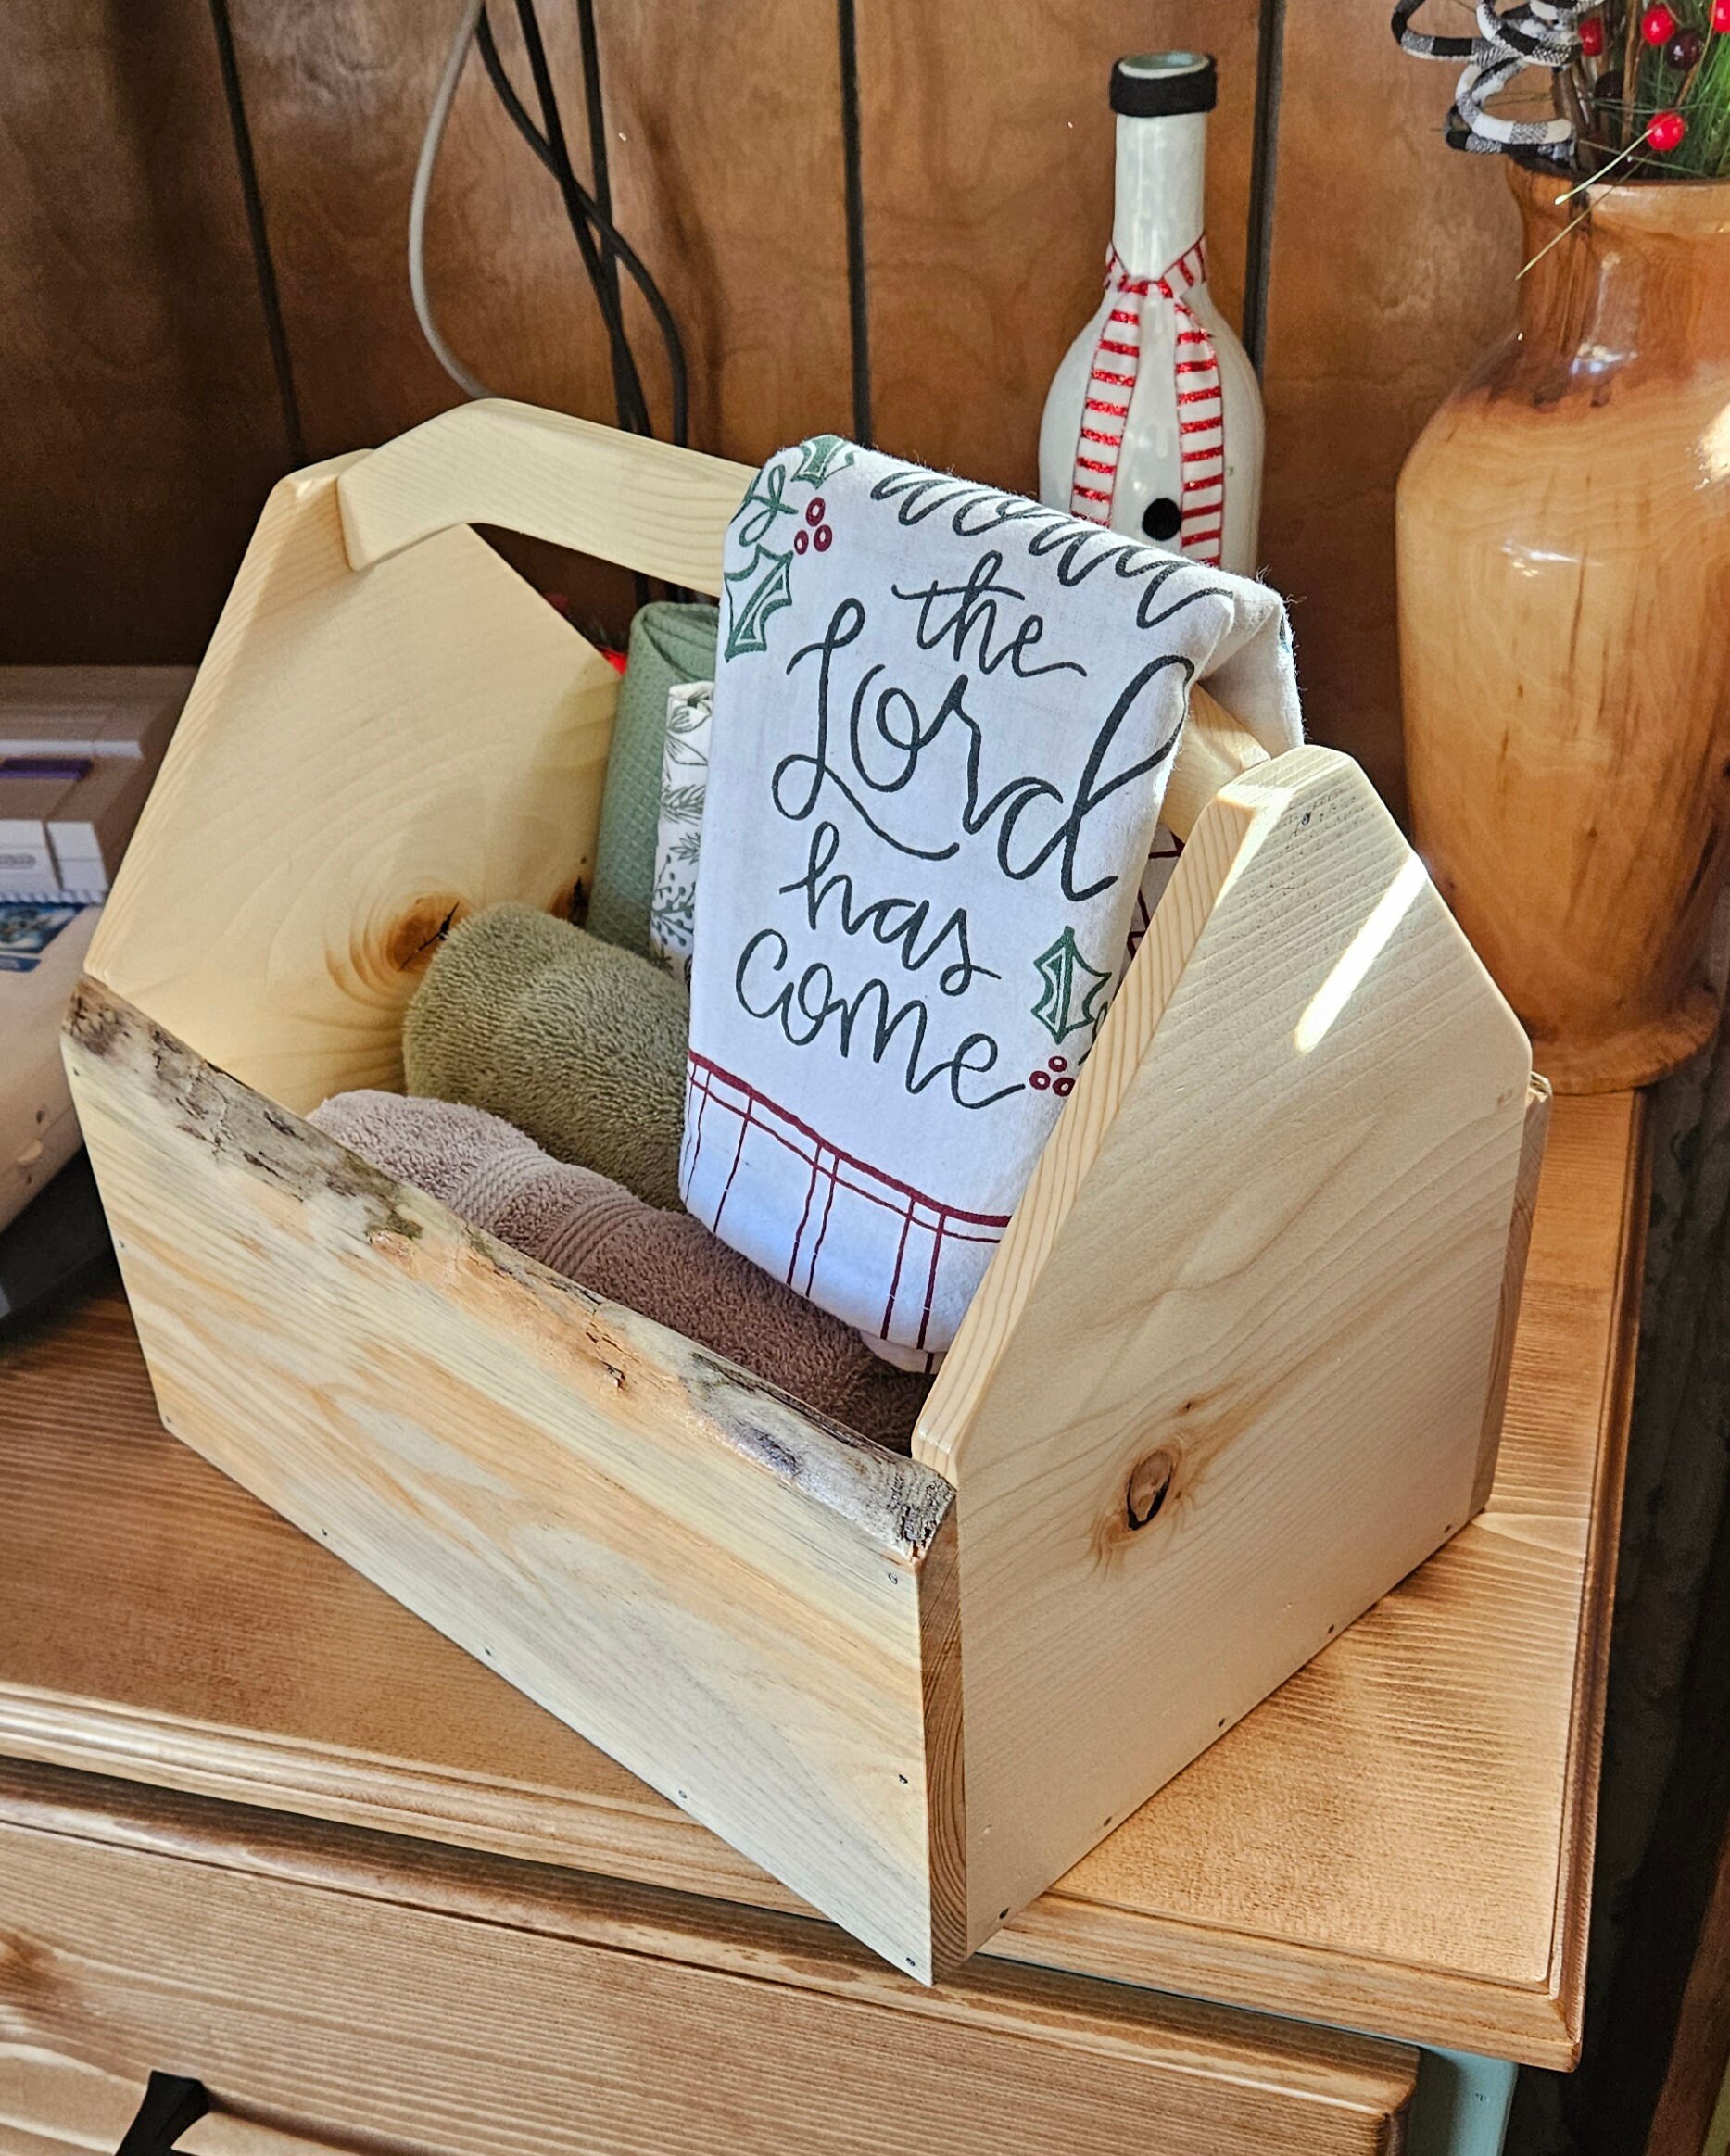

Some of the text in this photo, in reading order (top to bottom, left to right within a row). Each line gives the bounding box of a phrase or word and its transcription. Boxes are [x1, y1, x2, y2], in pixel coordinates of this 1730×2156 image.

[891, 550, 1087, 677] the
[772, 598, 1195, 902] Lord
[779, 821, 1002, 996] has
[736, 928, 1027, 1110] come
